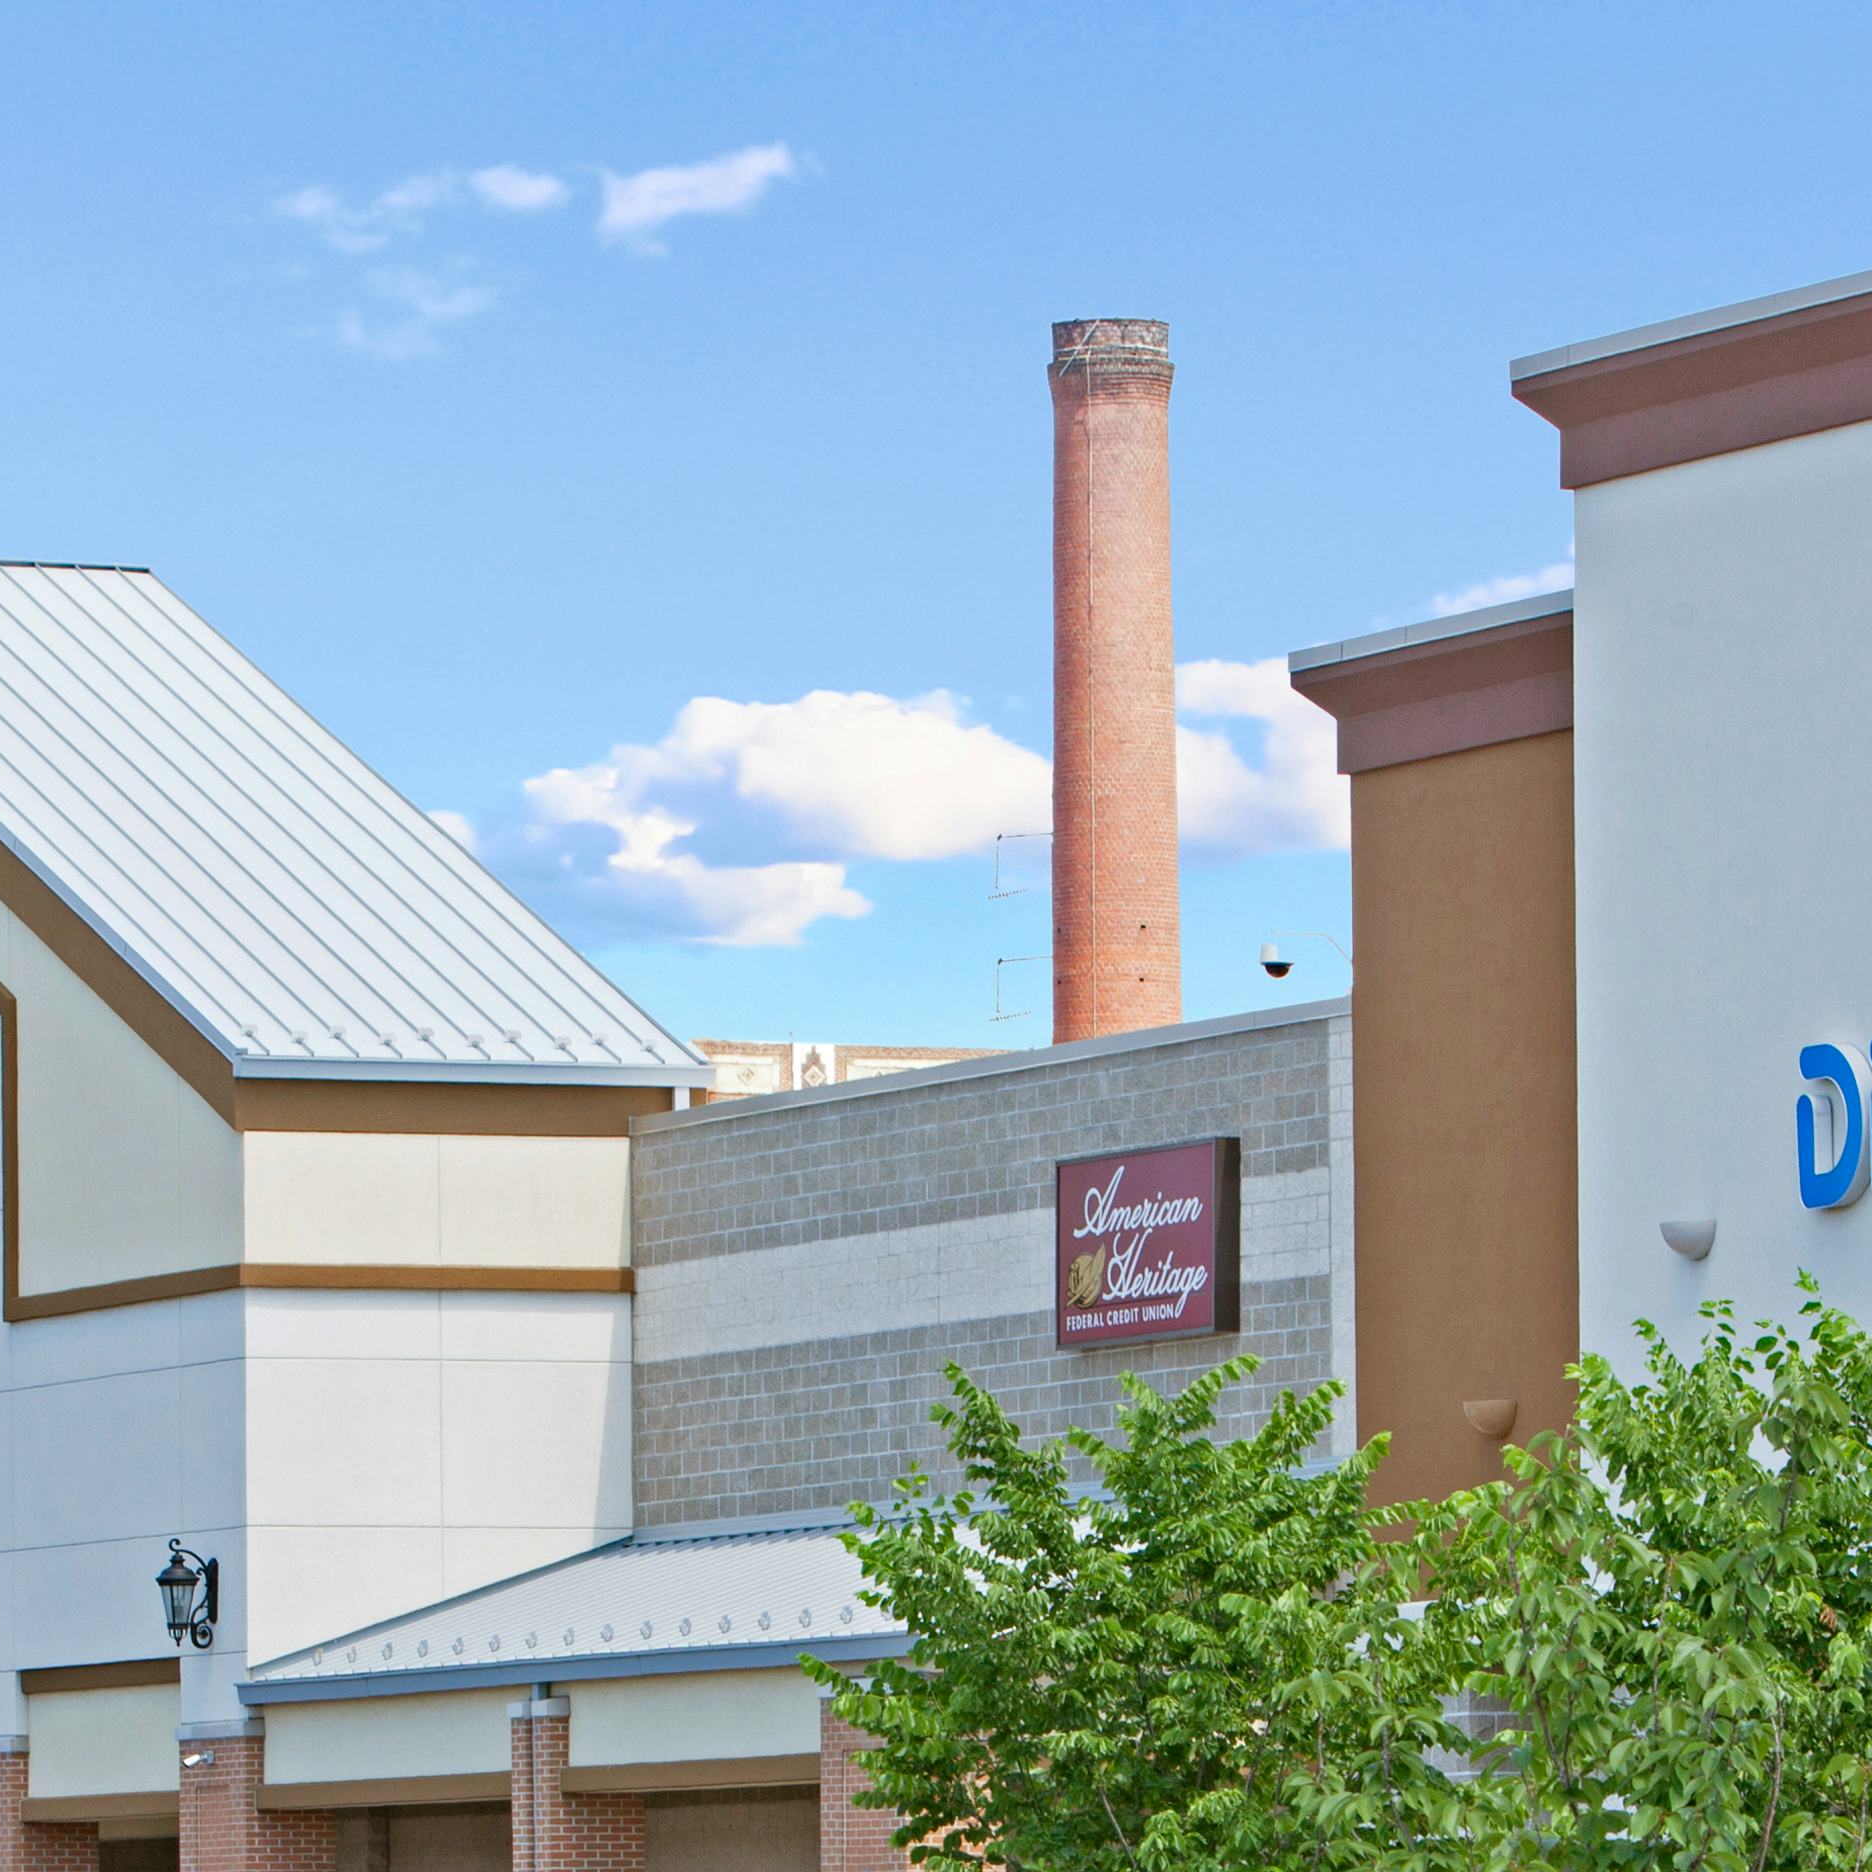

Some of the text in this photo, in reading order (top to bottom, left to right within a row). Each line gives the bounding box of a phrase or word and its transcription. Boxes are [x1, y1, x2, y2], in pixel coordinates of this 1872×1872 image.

[1073, 1165, 1203, 1238] American
[1102, 1228, 1208, 1318] Heritage
[1066, 1304, 1174, 1331] FEDERAL CREDIT UNION
